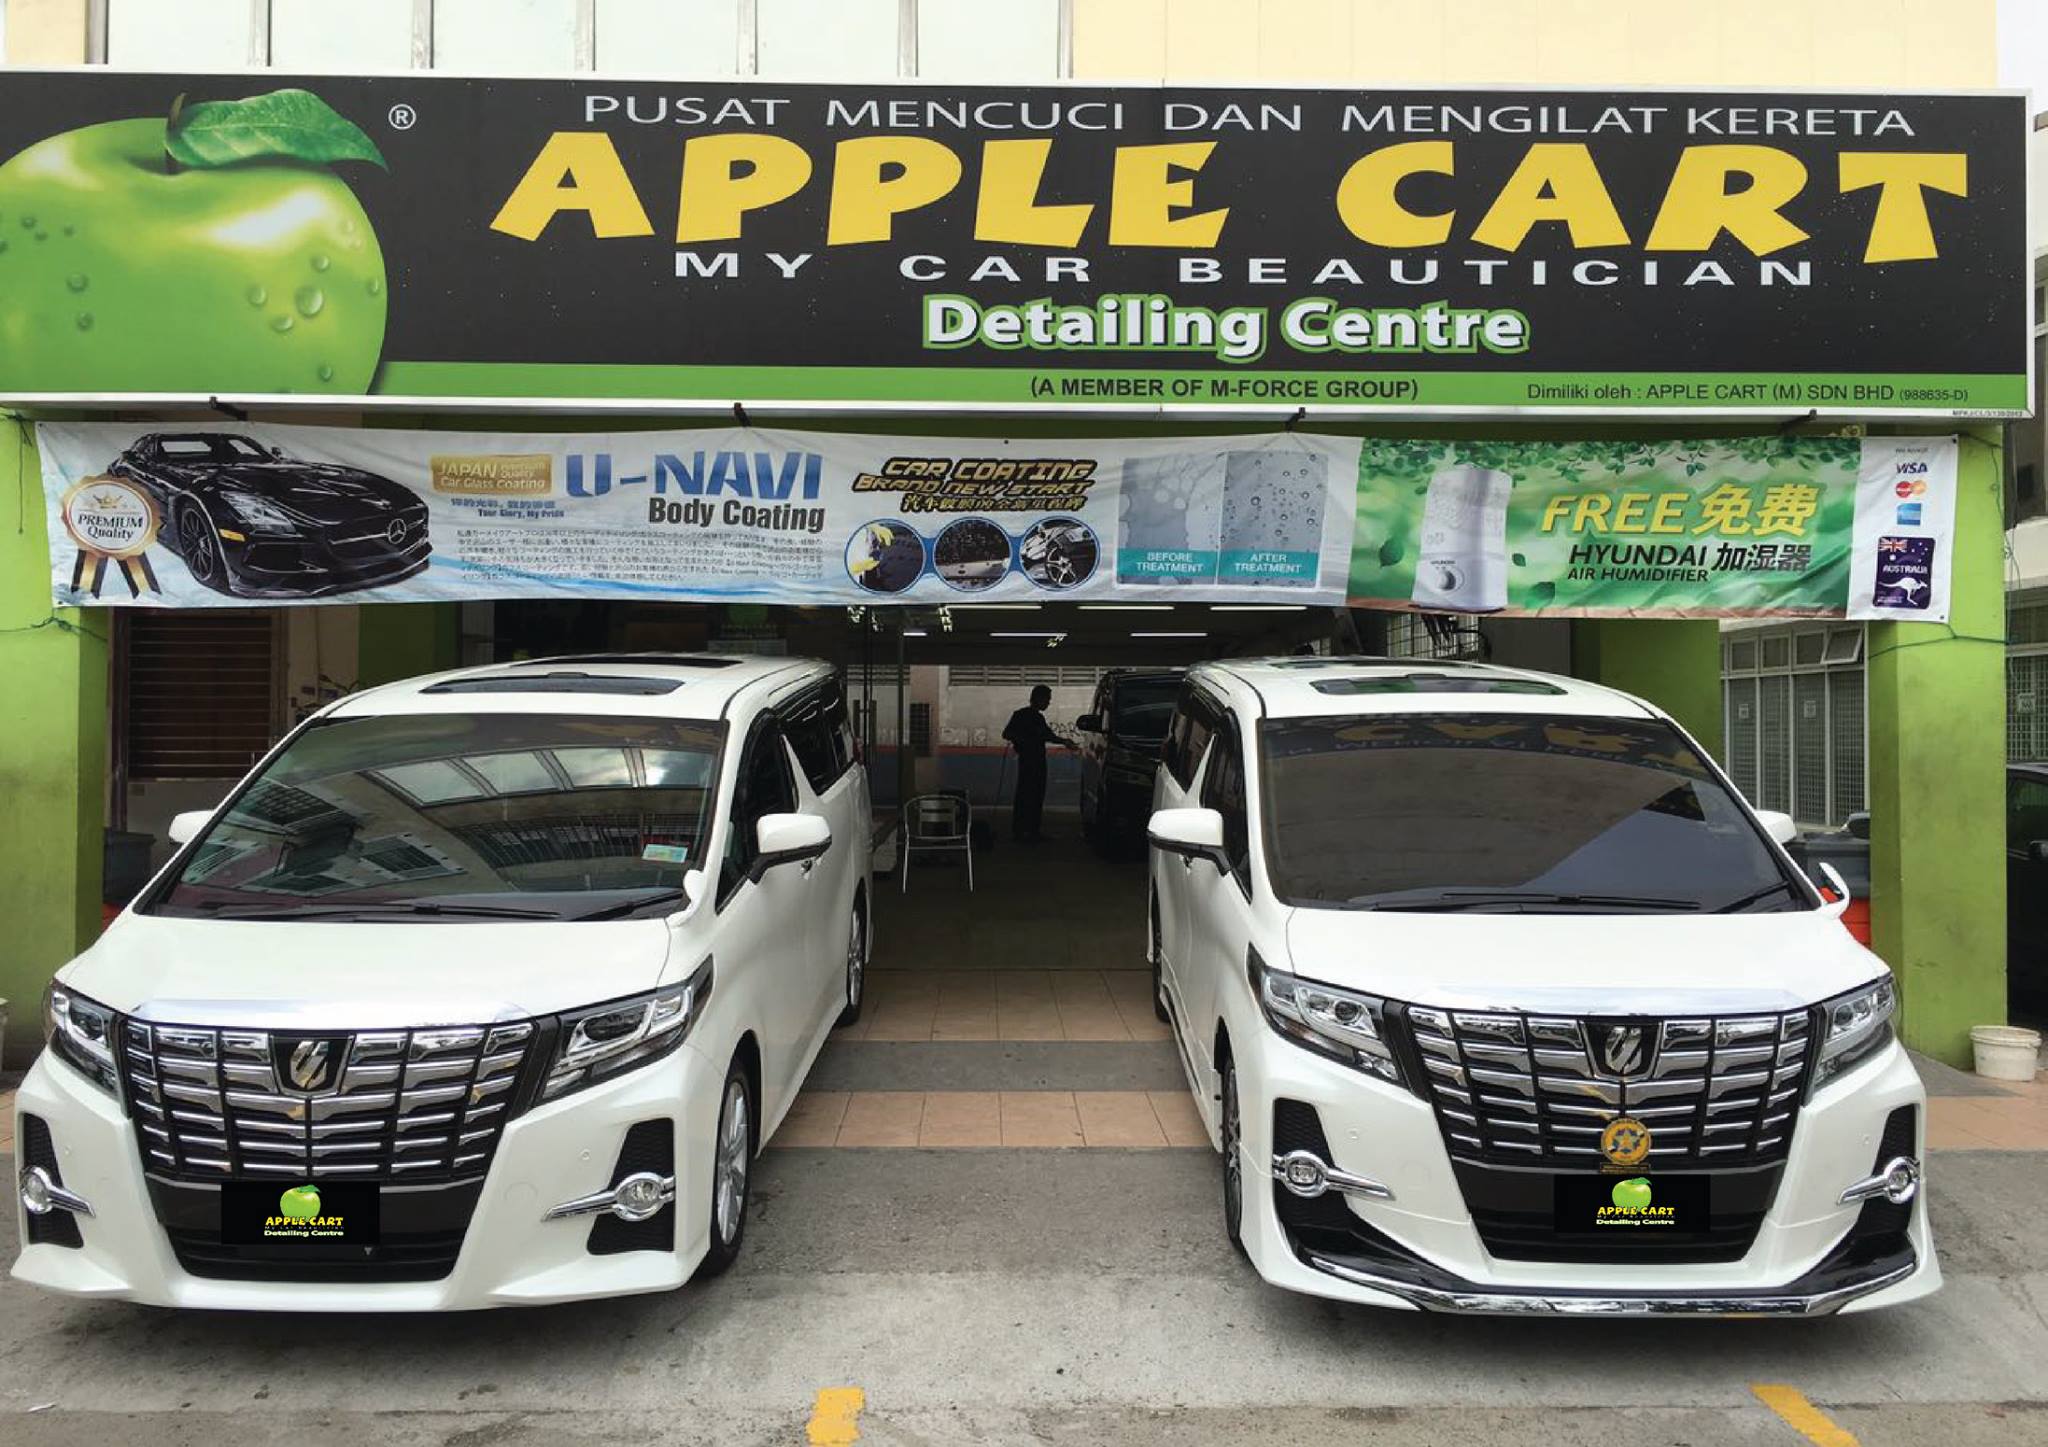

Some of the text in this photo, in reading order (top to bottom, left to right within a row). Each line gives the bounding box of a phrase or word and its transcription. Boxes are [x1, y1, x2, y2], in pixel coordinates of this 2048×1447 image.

[586, 95, 1916, 137] PUSAT MENCUCI DAN MENGILAT KERETA
[489, 131, 1969, 264] APPLE CART
[675, 252, 1812, 287] MY CAR BEAUTICIAN
[925, 296, 1526, 359] Detailing Centre
[1031, 376, 1419, 399] (A MEMBER OF M-FORCE GROUP)
[1527, 383, 1597, 400] Dimiliki
[1600, 384, 1632, 400] oleh
[1646, 385, 1709, 400] APPLE
[1714, 385, 1768, 400] CART
[1772, 383, 1802, 402] (M)
[1807, 385, 1849, 401] SDN
[1854, 386, 1894, 401] BHD
[1899, 388, 1969, 402] (988635-D)
[440, 462, 498, 478] JAPAN
[883, 459, 1096, 479] CAR COATING
[1896, 462, 1928, 474] VISA
[496, 479, 545, 490] Coating
[854, 475, 942, 491] BRAND
[1005, 481, 1094, 495] START
[649, 497, 825, 533] Body Coating
[1541, 483, 1819, 537] FREE 免费
[77, 513, 143, 529] PREMIUM
[87, 526, 134, 541] Quality
[1146, 552, 1194, 563] BEFORE
[1250, 553, 1287, 562] AFTER
[1568, 542, 1812, 572] HYUNDAI 加湿器
[1136, 562, 1204, 573] TREATMENT
[1234, 563, 1302, 573] TREATMENT
[1567, 567, 1709, 582] AIR HUMIDIFIER
[1882, 564, 1928, 574] AUSTRALIA
